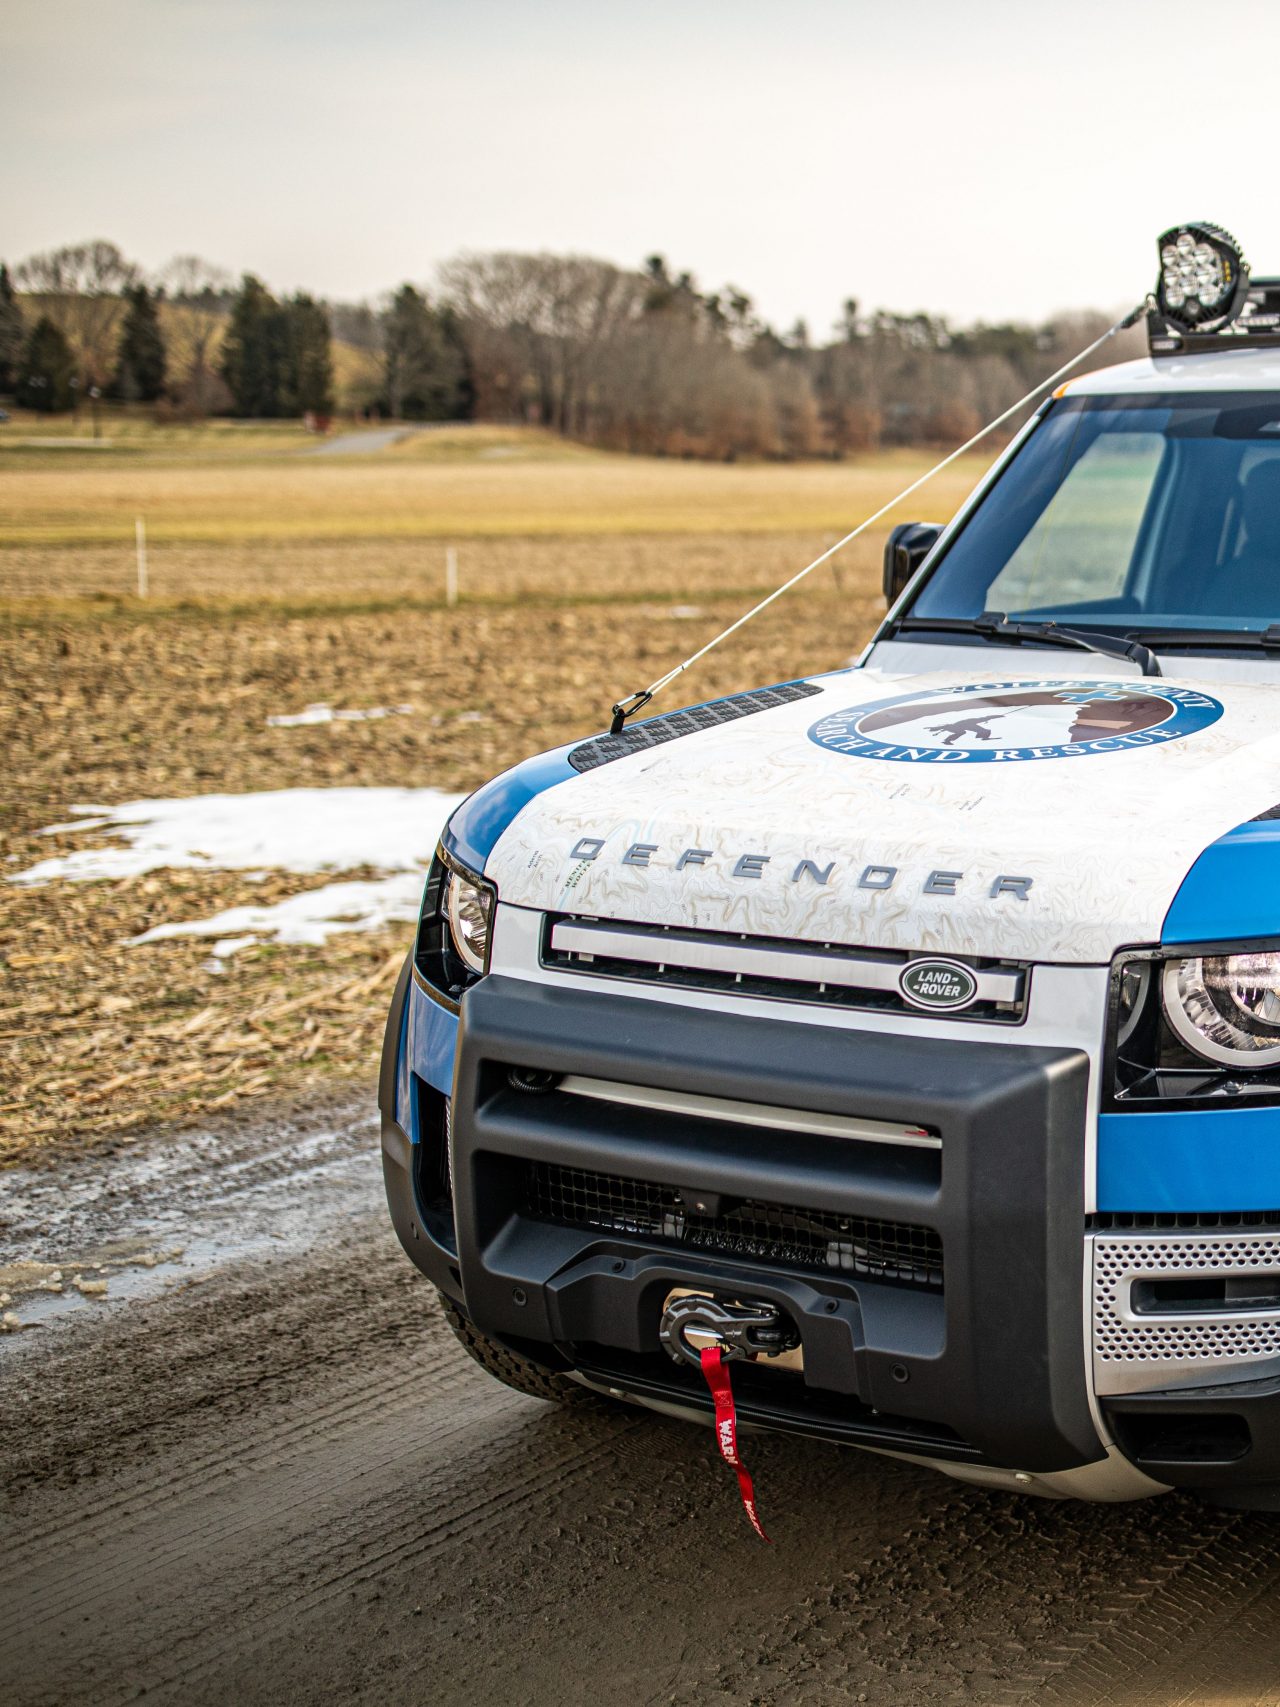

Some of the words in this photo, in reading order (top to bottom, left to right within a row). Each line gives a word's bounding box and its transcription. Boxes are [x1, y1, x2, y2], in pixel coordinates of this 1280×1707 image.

[1097, 682, 1216, 709] COUNTY
[815, 711, 875, 751] SEARCH
[862, 747, 970, 761] AND
[991, 728, 1182, 761] RESCUE
[570, 837, 1034, 901] DEFENDER
[918, 970, 951, 984] LAND
[919, 983, 961, 997] ROVER
[718, 1419, 739, 1465] WARN
